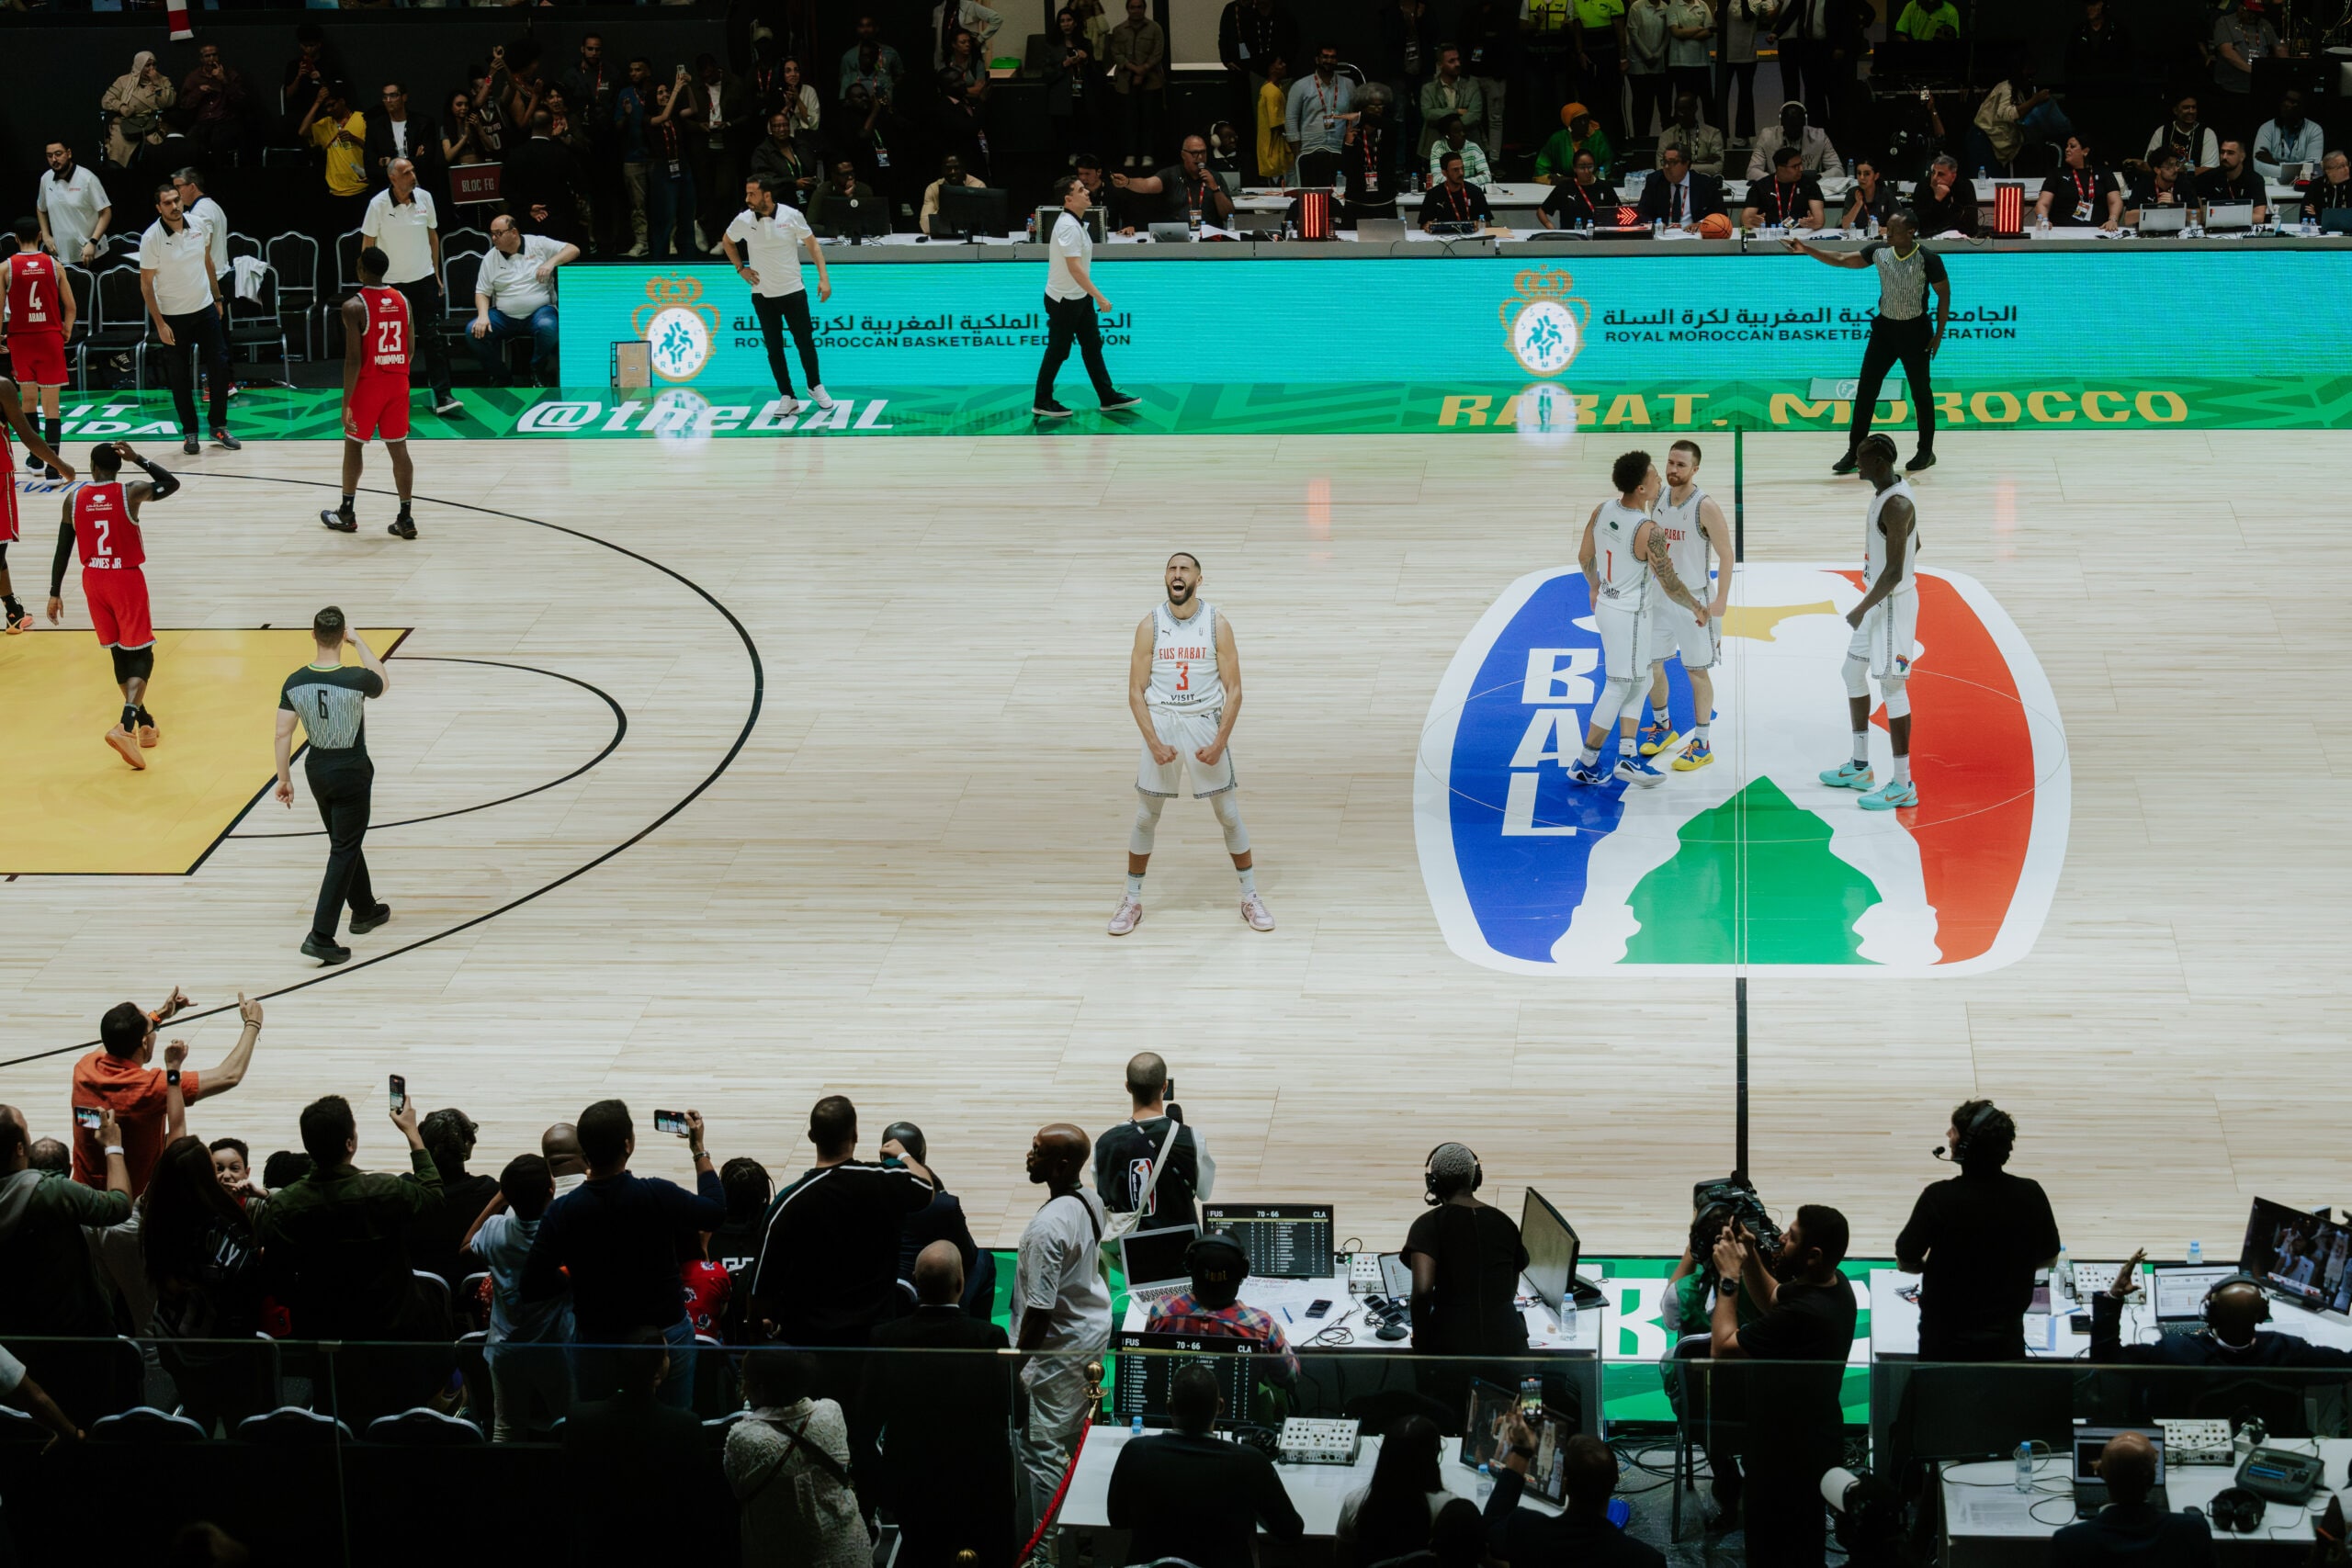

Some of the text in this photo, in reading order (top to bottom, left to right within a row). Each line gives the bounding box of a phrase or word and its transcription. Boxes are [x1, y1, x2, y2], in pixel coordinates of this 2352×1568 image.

[29, 280, 42, 310] 4
[861, 315, 953, 334] المغربية
[960, 313, 1038, 334] الملكية
[1602, 309, 1674, 325] السلة
[1681, 308, 1728, 329] لكرة
[1736, 308, 1831, 329] المغربية
[379, 321, 401, 353] 23
[812, 336, 899, 348] OROCCAN
[903, 336, 1016, 347] BASKETBALL
[1605, 331, 1664, 342] ROYAL
[1669, 330, 1774, 342] MOROCCAN
[1779, 328, 1875, 341] BASKETBA
[95, 520, 112, 556] 2
[88, 557, 122, 570] JONES JR
[1606, 549, 1612, 584] 1
[1159, 647, 1207, 660] FUS RABAT
[1176, 661, 1189, 691] 3
[1170, 694, 1195, 702] VISIT
[1501, 648, 1599, 836] BAL
[1209, 1210, 1224, 1218] FUS
[1125, 1337, 1140, 1347] FUS
[1176, 1341, 1185, 1349] 70
[1191, 1342, 1201, 1350] 66
[1237, 1345, 1252, 1353] CLA
